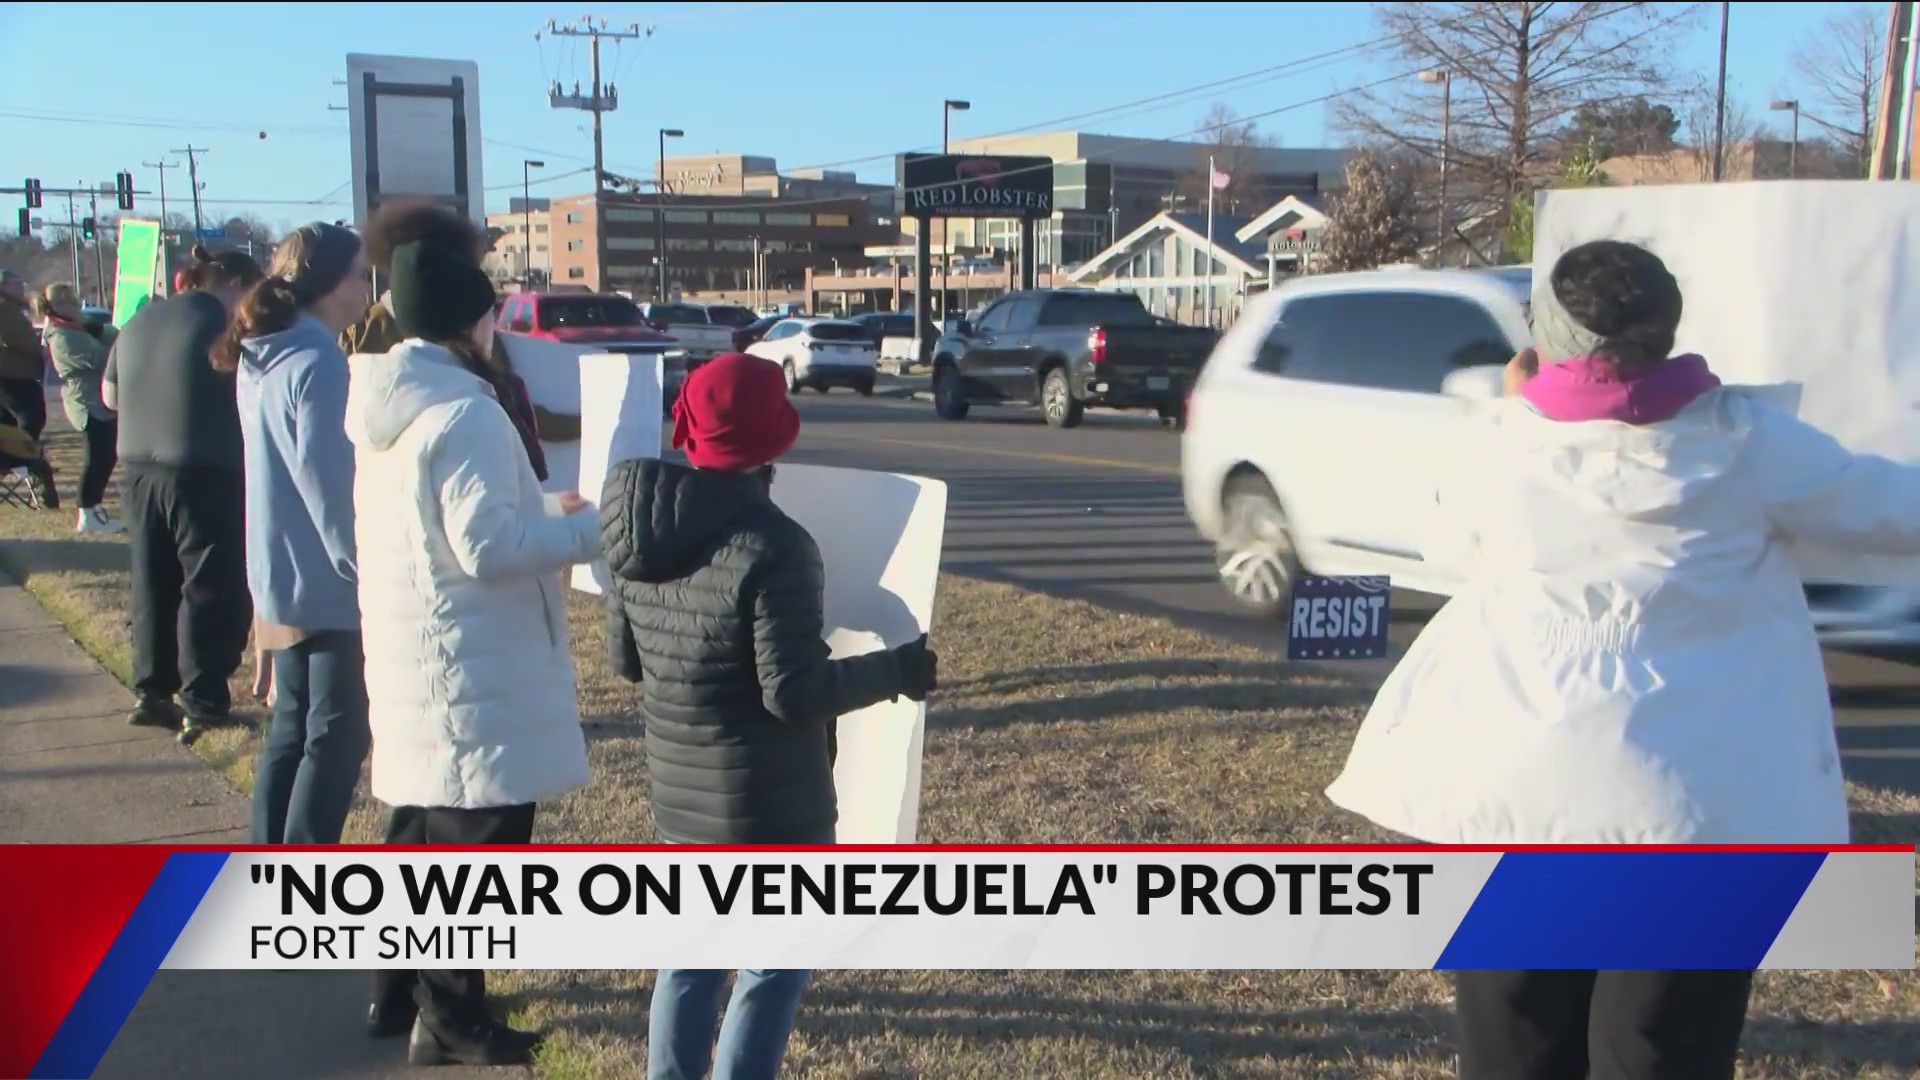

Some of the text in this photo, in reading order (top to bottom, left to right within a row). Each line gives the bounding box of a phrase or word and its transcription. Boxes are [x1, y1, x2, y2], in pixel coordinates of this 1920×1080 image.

[678, 169, 714, 188] Mercy
[912, 184, 1049, 210] RED LOBSTER
[1291, 595, 1386, 639] RESIST
